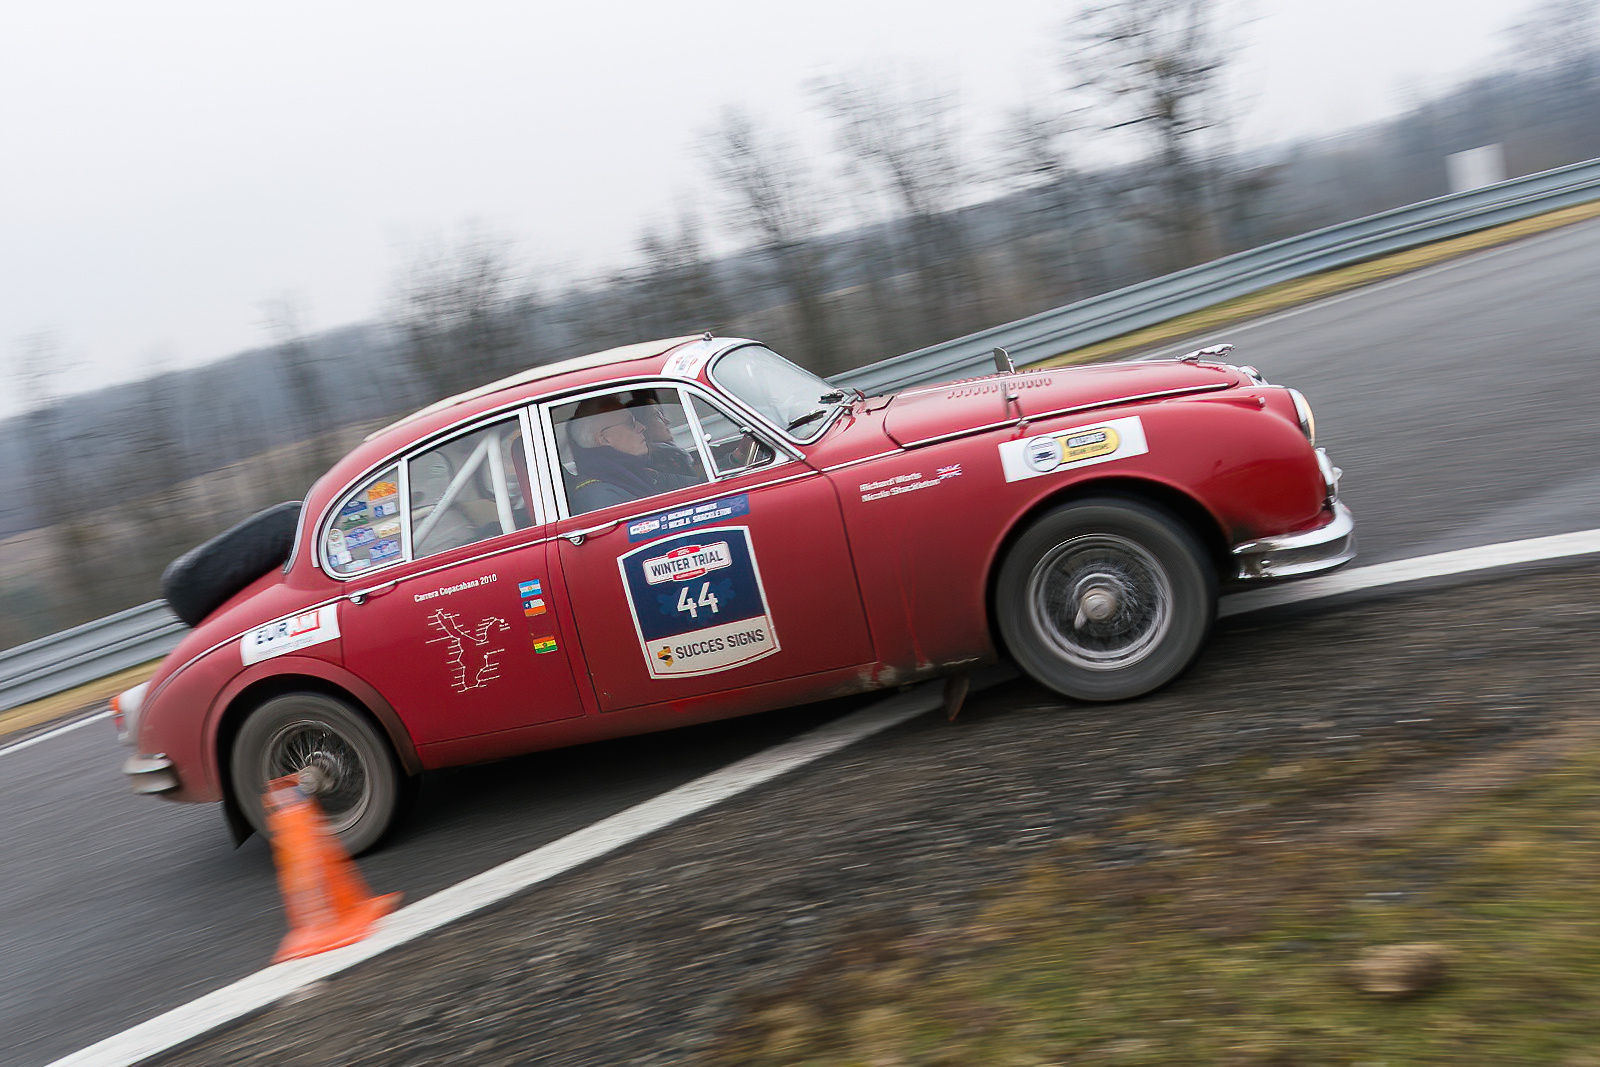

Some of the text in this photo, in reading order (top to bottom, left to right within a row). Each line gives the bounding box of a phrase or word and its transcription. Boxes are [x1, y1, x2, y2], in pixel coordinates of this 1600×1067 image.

[651, 558, 690, 577] WINTER
[692, 550, 724, 567] TRIAL
[414, 574, 497, 602] Carrera Copacabana 2010
[676, 582, 719, 618] 44
[676, 628, 765, 660] SUCCES SIGNS
